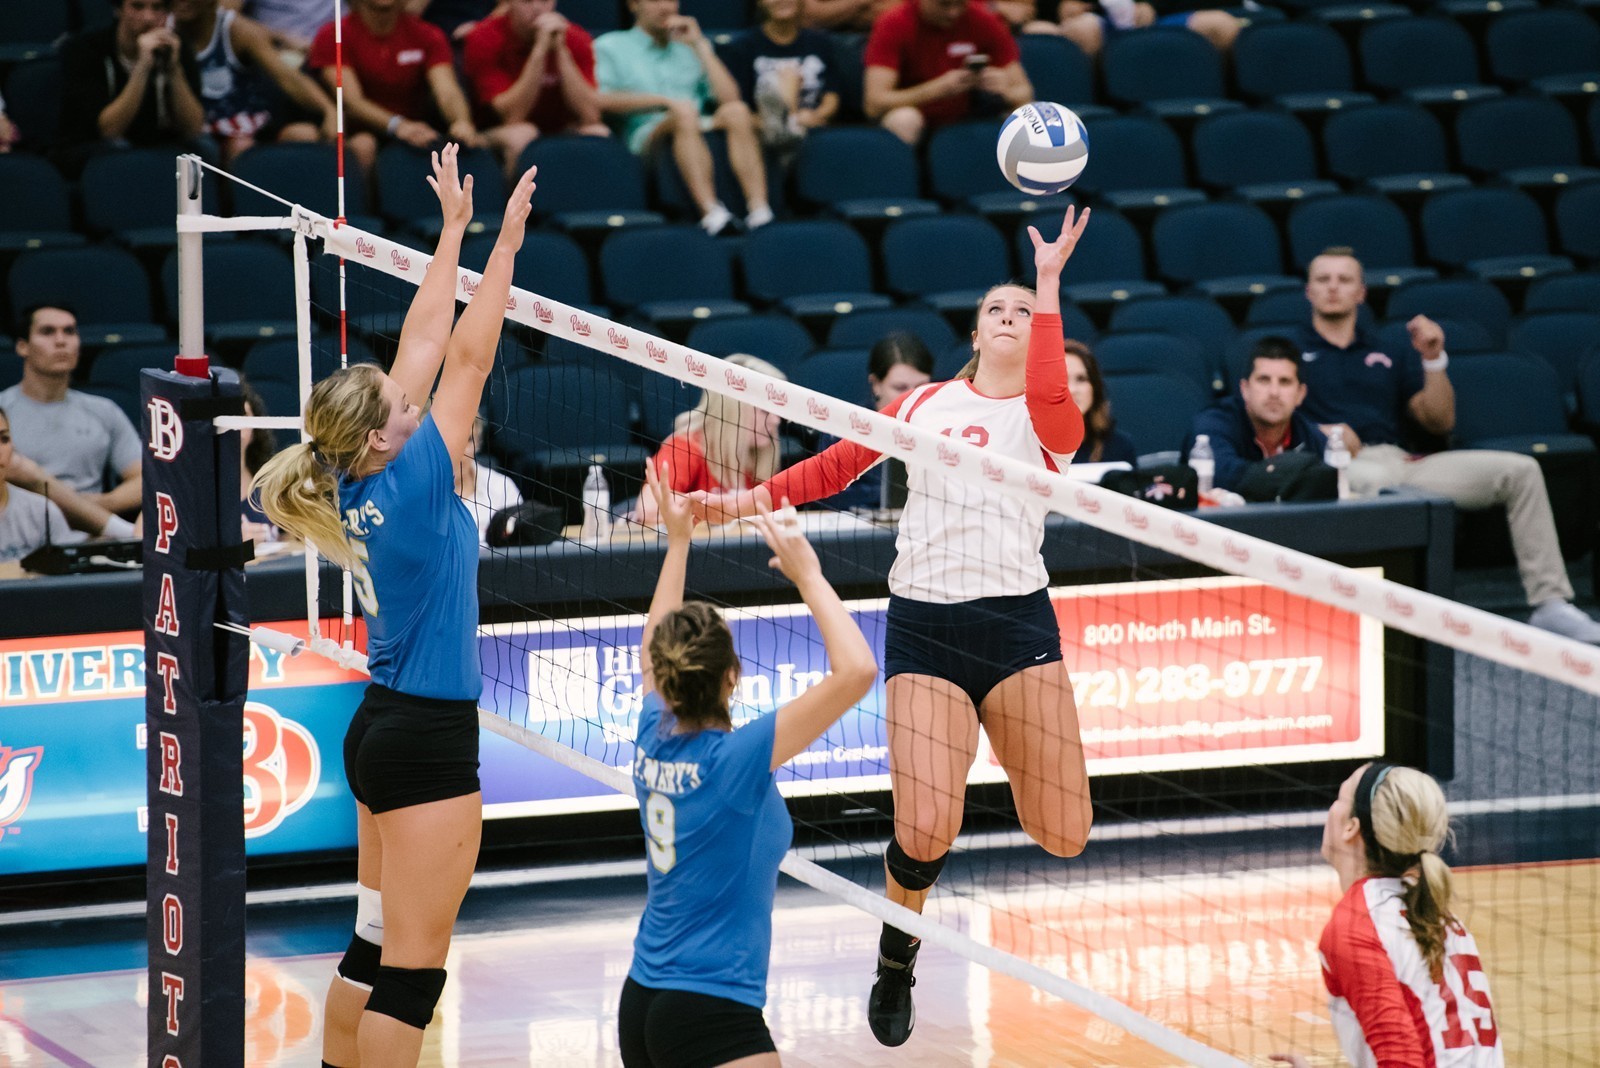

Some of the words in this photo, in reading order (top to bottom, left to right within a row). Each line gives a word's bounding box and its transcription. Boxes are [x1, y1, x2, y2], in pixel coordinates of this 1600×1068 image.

[355, 237, 376, 259] Patriots
[391, 249, 411, 271] Patriots
[533, 301, 554, 324] Patriots
[570, 314, 592, 337] Patriots
[608, 327, 629, 350] Patriots
[646, 341, 668, 364] Patriots
[685, 354, 707, 377] Patriots
[725, 368, 747, 391] Patriots
[765, 383, 788, 406] Patriots
[1084, 623, 1124, 647] 800
[1127, 619, 1186, 643] North
[1190, 615, 1244, 639] Main
[1247, 613, 1277, 635] St.
[1068, 666, 1130, 710] 72)
[1134, 655, 1324, 704] 283-9777
[154, 491, 185, 1068] PATRIOT
[646, 791, 677, 876] 9
[1441, 953, 1498, 1050] 15
